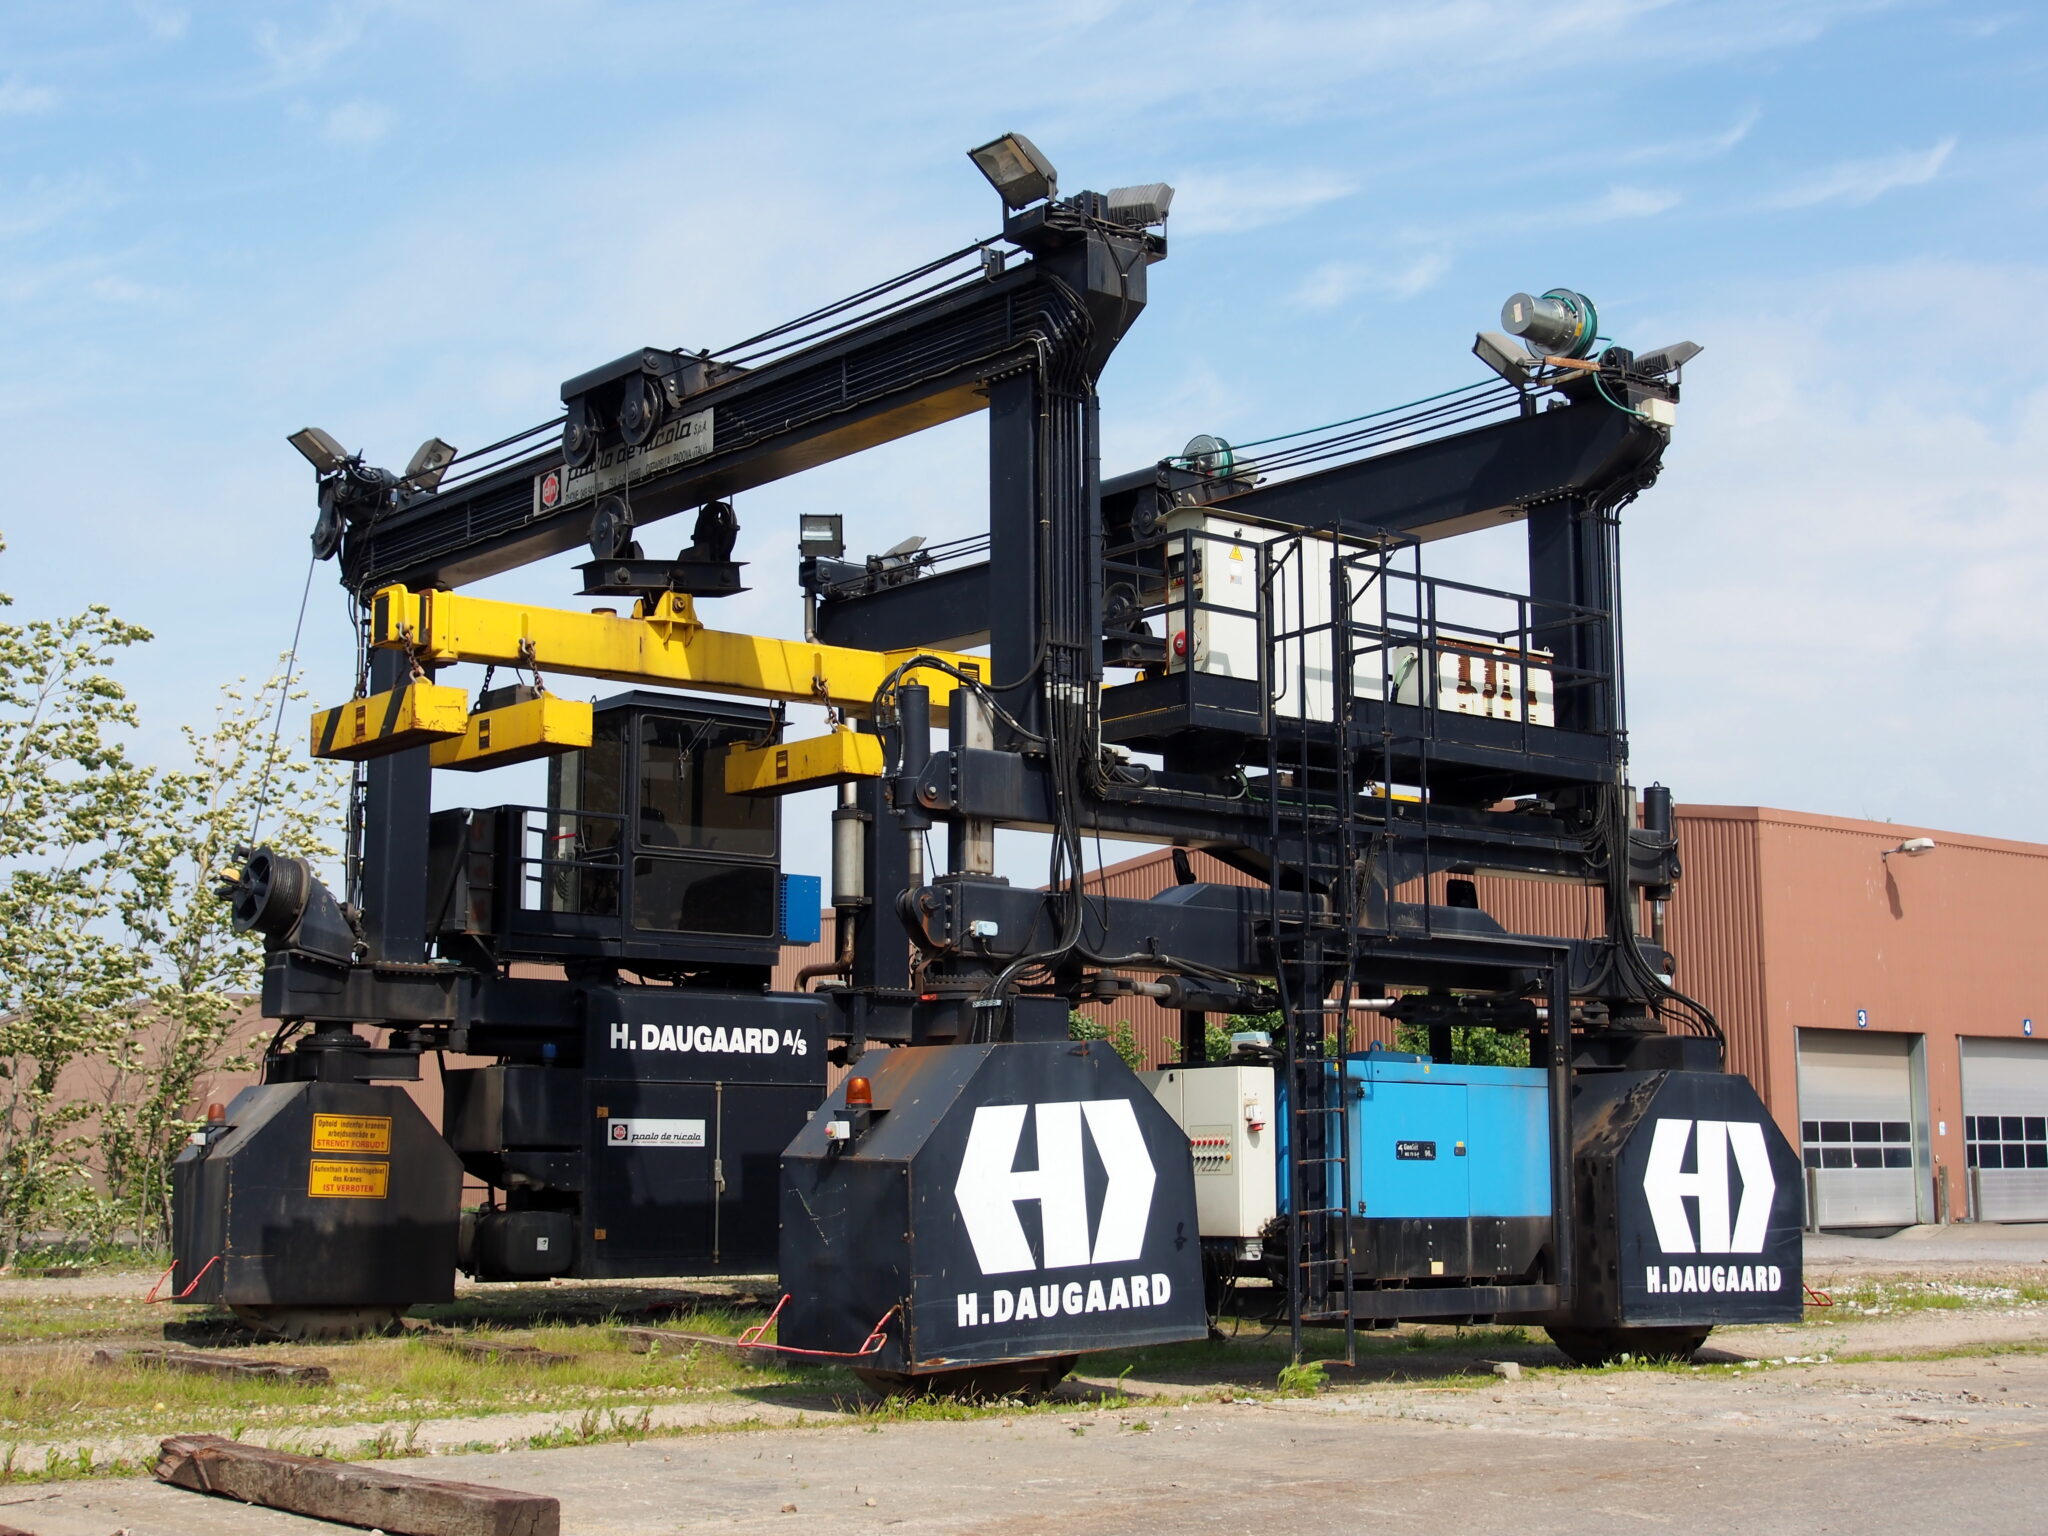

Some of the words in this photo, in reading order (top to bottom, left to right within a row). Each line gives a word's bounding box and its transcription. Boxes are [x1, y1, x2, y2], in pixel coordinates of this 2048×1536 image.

[1858, 1011, 1866, 1026] 3
[2024, 1021, 2031, 1033] 4
[610, 1023, 636, 1050] H.
[642, 1024, 779, 1054] DAUGAARD
[782, 1028, 807, 1056] A/S
[316, 1139, 349, 1148] STRENGT
[631, 1132, 659, 1143] paolo
[661, 1132, 671, 1141] de
[673, 1132, 702, 1141] nicola
[336, 1184, 374, 1192] VERBOTEN
[1646, 1265, 1781, 1293] H.DAUGAARD
[957, 1272, 1172, 1328] H.DAUGAARD
